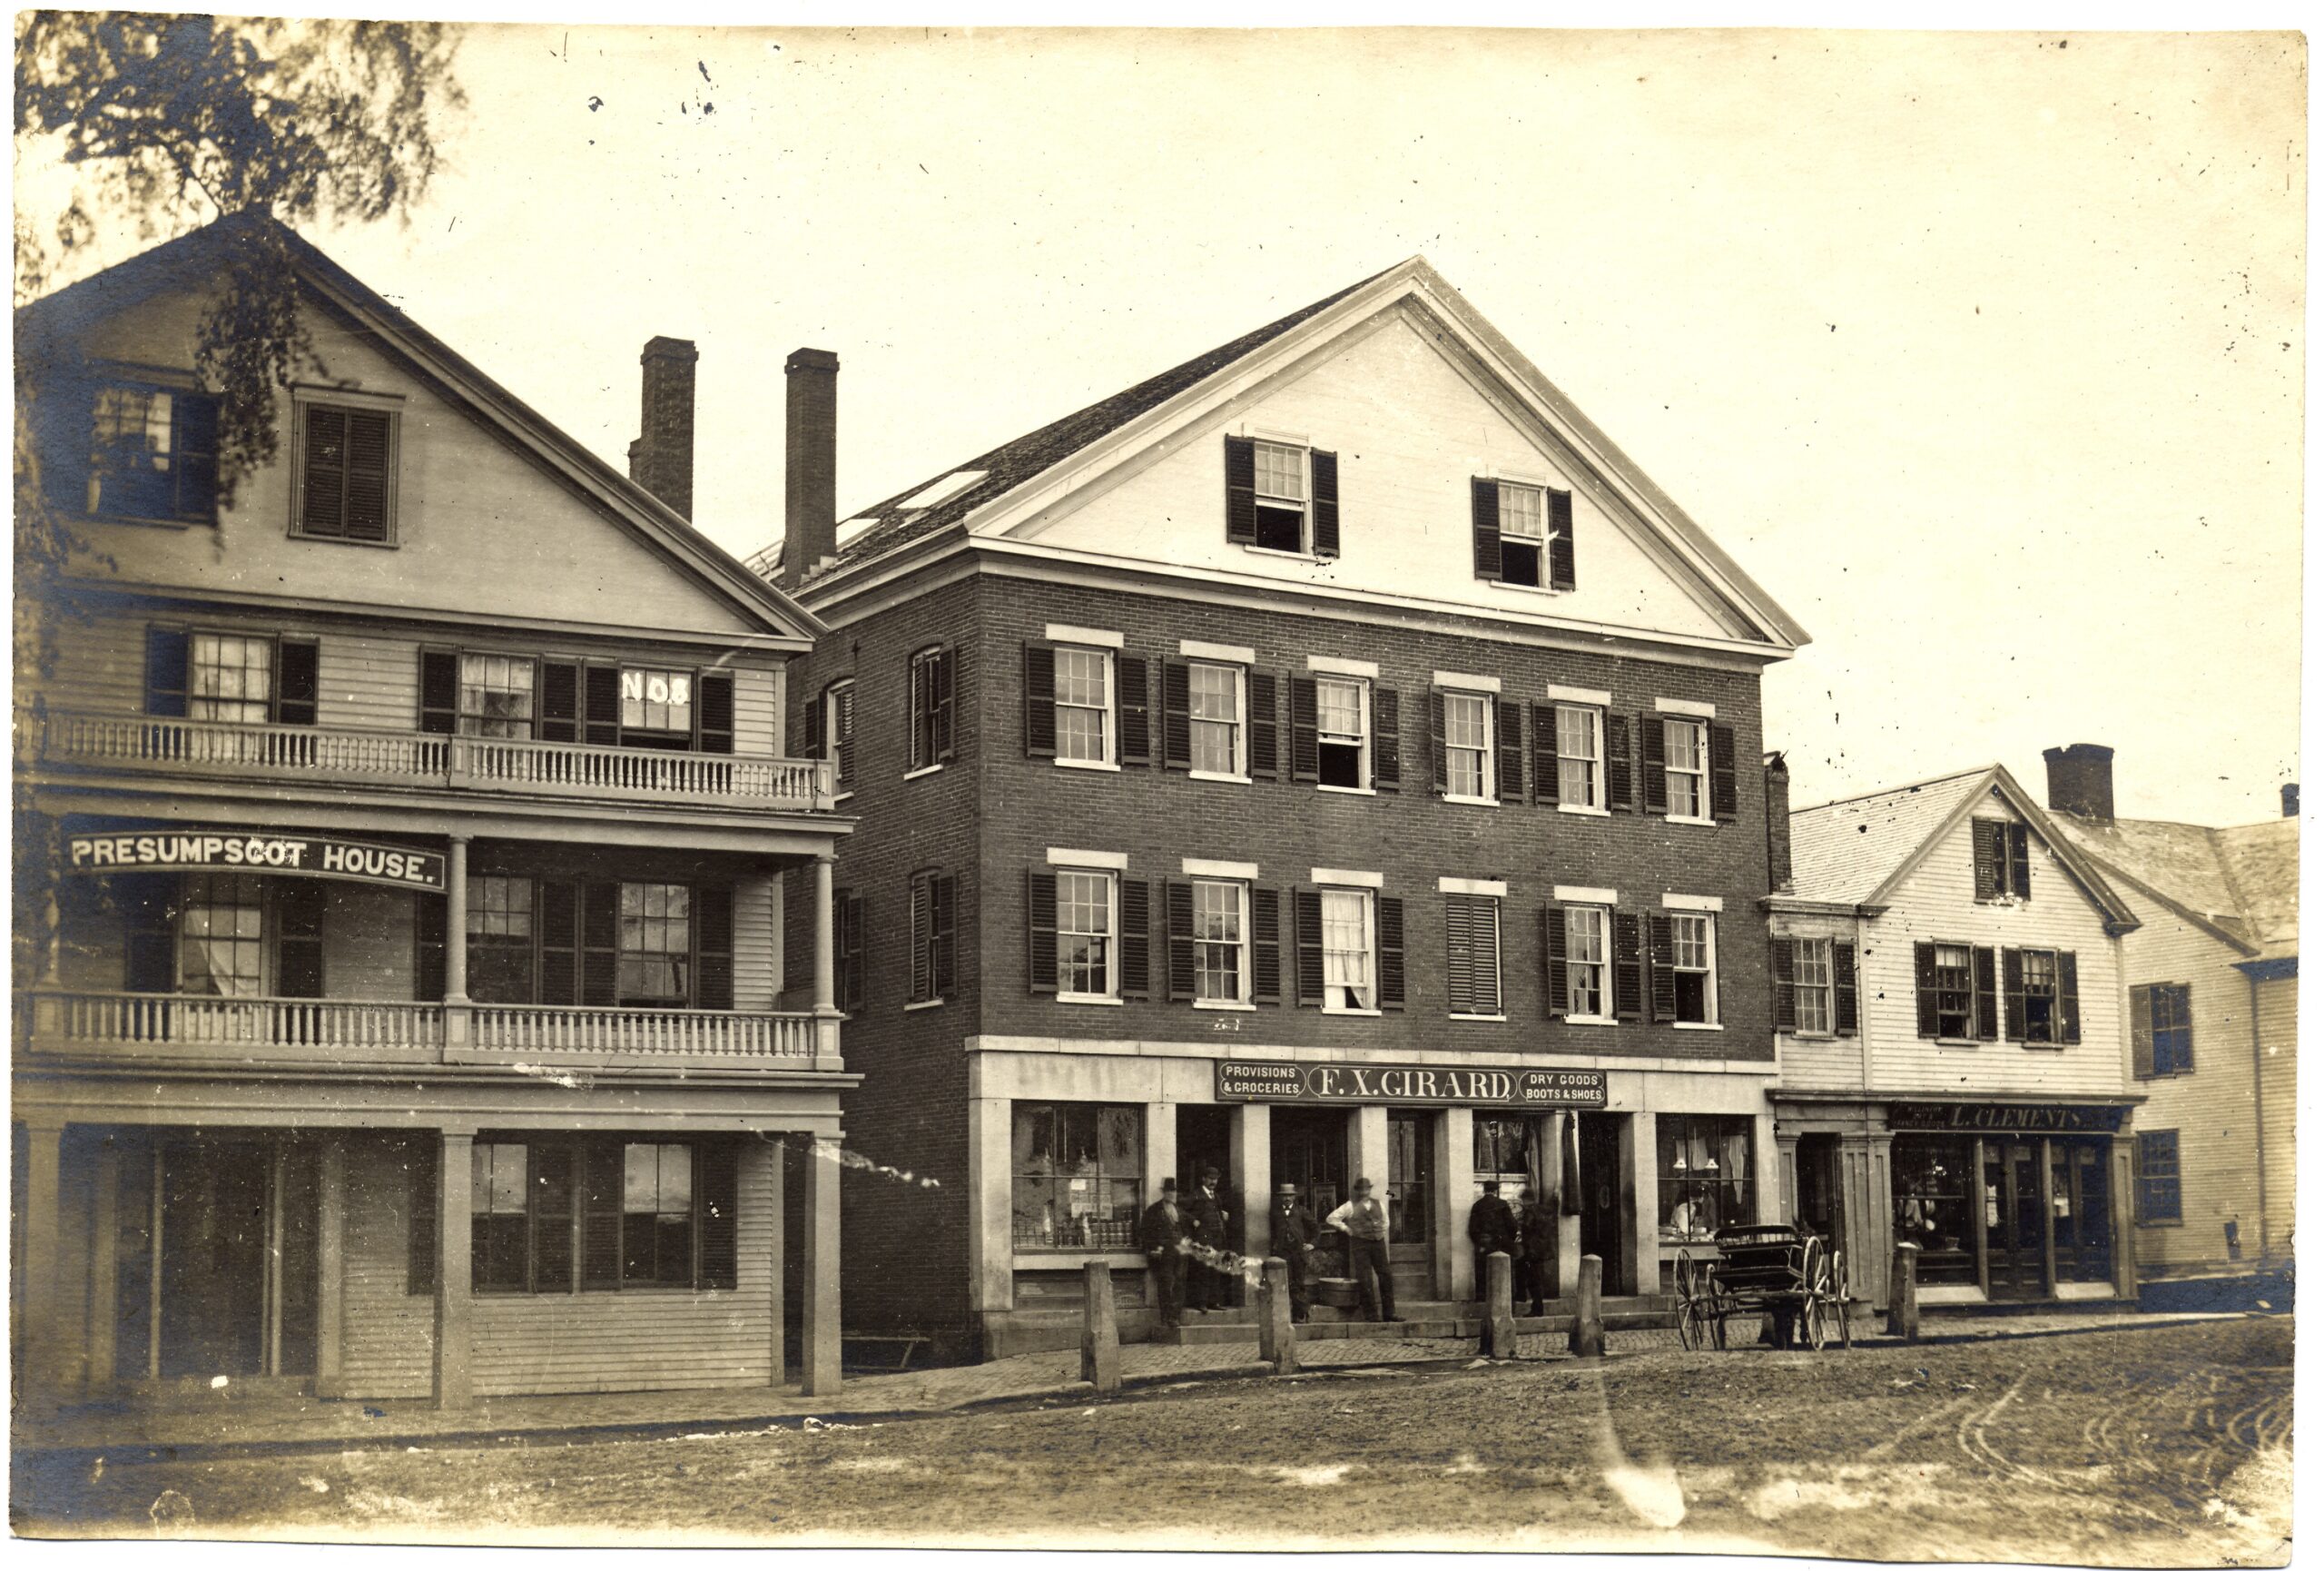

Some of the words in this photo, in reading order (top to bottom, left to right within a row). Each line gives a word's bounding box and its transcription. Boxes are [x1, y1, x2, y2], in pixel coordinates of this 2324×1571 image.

[72, 836, 307, 868] PRESUMPSCOT
[323, 845, 435, 884] HOUSE.
[1226, 1066, 1296, 1079] PROVISIONS
[1320, 1068, 1344, 1095] F.
[1351, 1069, 1379, 1096] X.
[1530, 1073, 1553, 1085] DRY
[1560, 1074, 1599, 1086] GOODS
[1224, 1082, 1232, 1092] &
[1234, 1082, 1299, 1094] GROCERIES
[1526, 1089, 1561, 1100] BOOTS
[1951, 1105, 1970, 1127] L.
